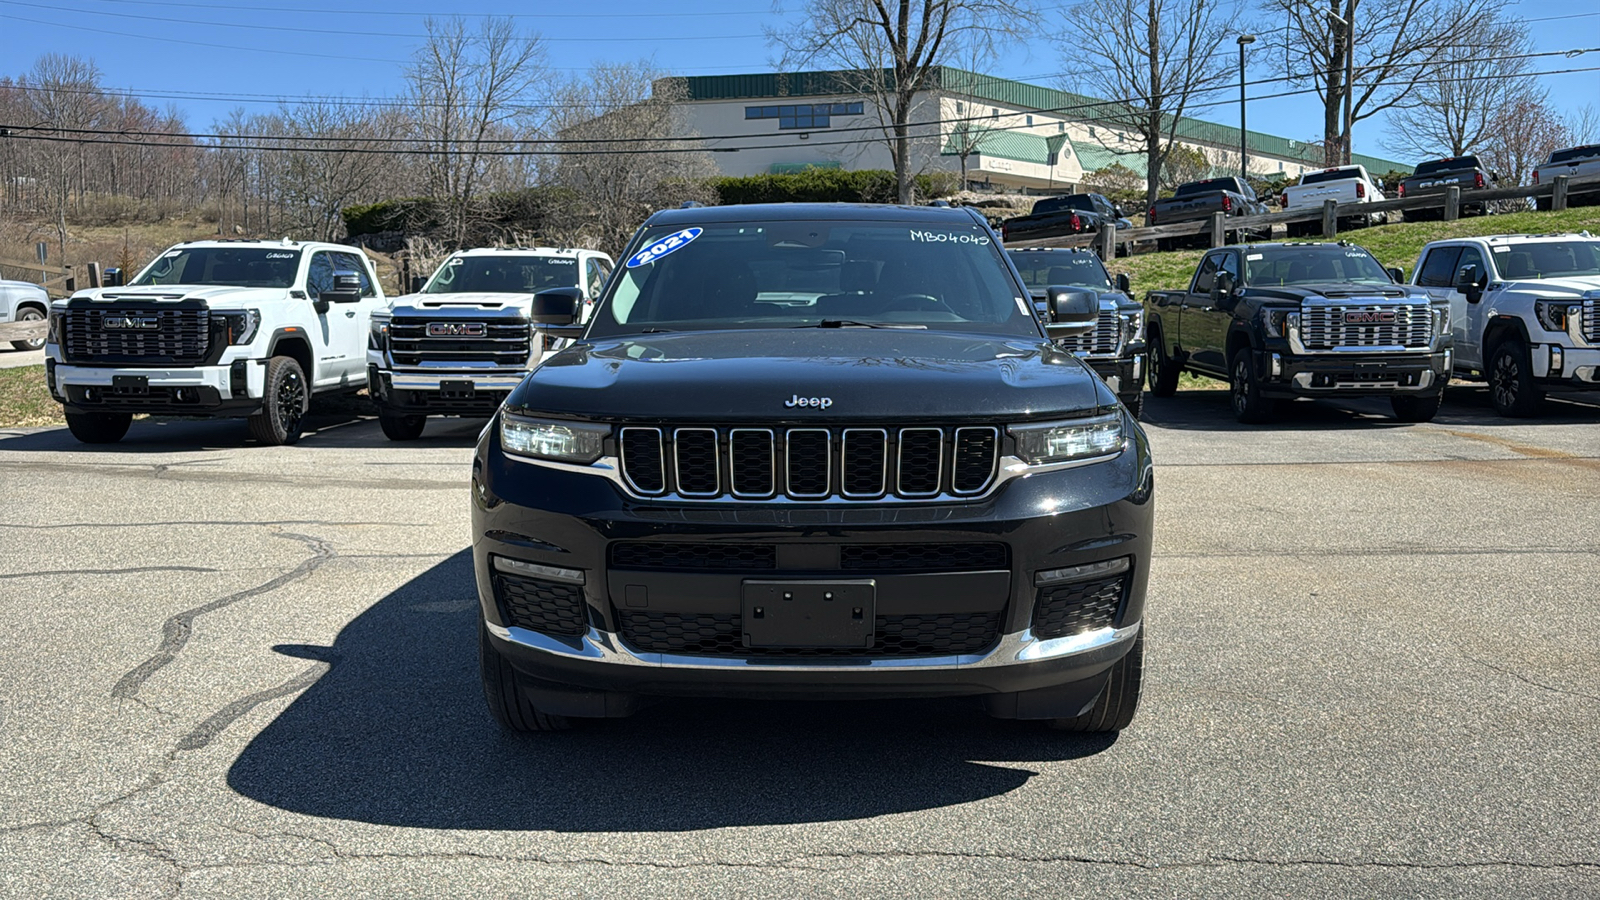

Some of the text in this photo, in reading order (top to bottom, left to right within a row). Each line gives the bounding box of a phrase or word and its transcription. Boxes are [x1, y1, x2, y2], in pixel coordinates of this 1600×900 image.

[636, 230, 694, 264] 2021
[104, 317, 158, 328] GMC
[1346, 312, 1395, 323] GMC
[430, 324, 483, 335] GMC
[784, 394, 833, 410] Jeep
